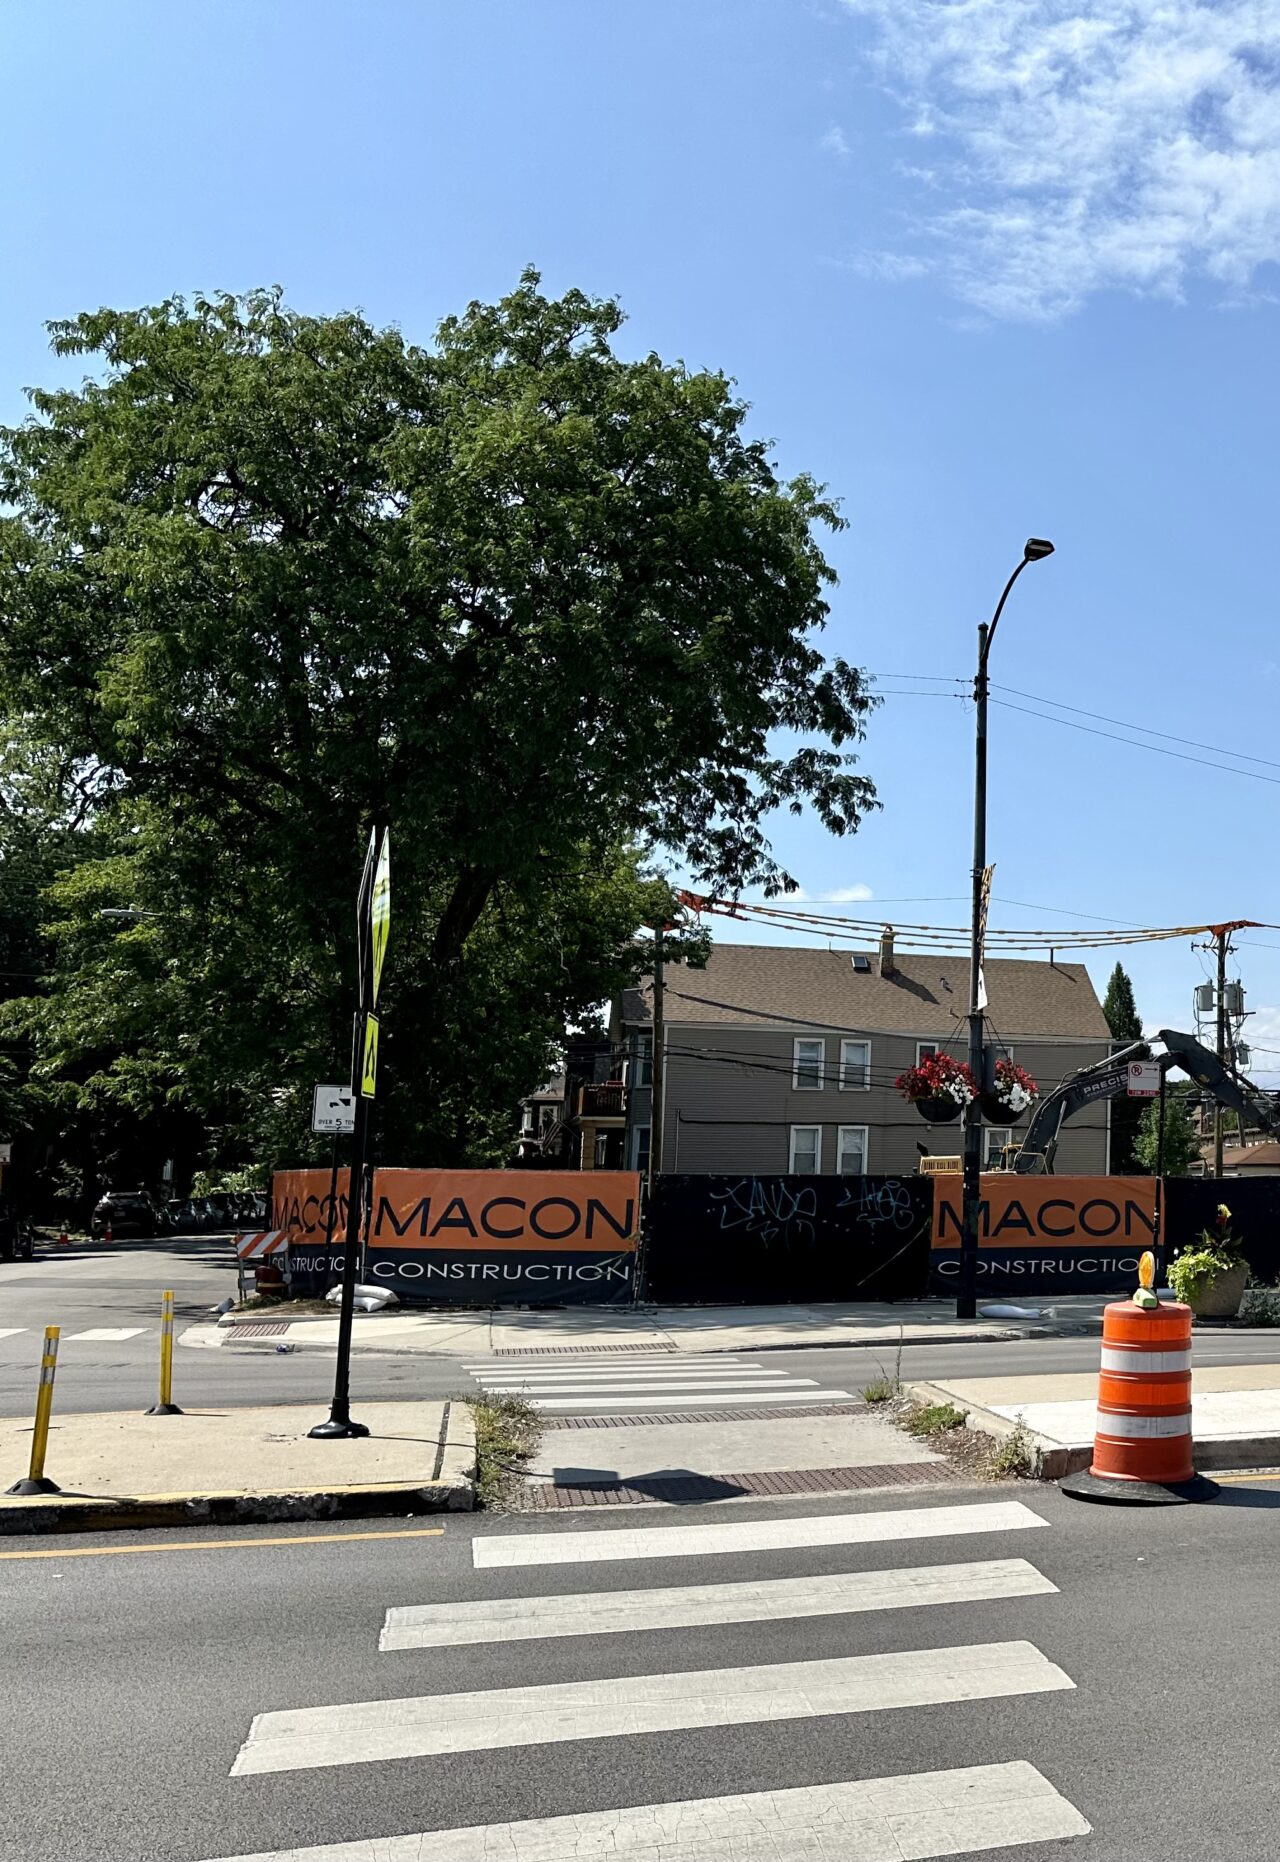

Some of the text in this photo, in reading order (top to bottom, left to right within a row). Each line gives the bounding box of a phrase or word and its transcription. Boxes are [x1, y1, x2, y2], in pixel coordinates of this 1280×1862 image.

[1084, 1073, 1128, 1093] PRECIS
[335, 1118, 343, 1127] 5
[374, 1196, 634, 1240] MACON
[372, 1261, 629, 1281] CONSTRUCTION
